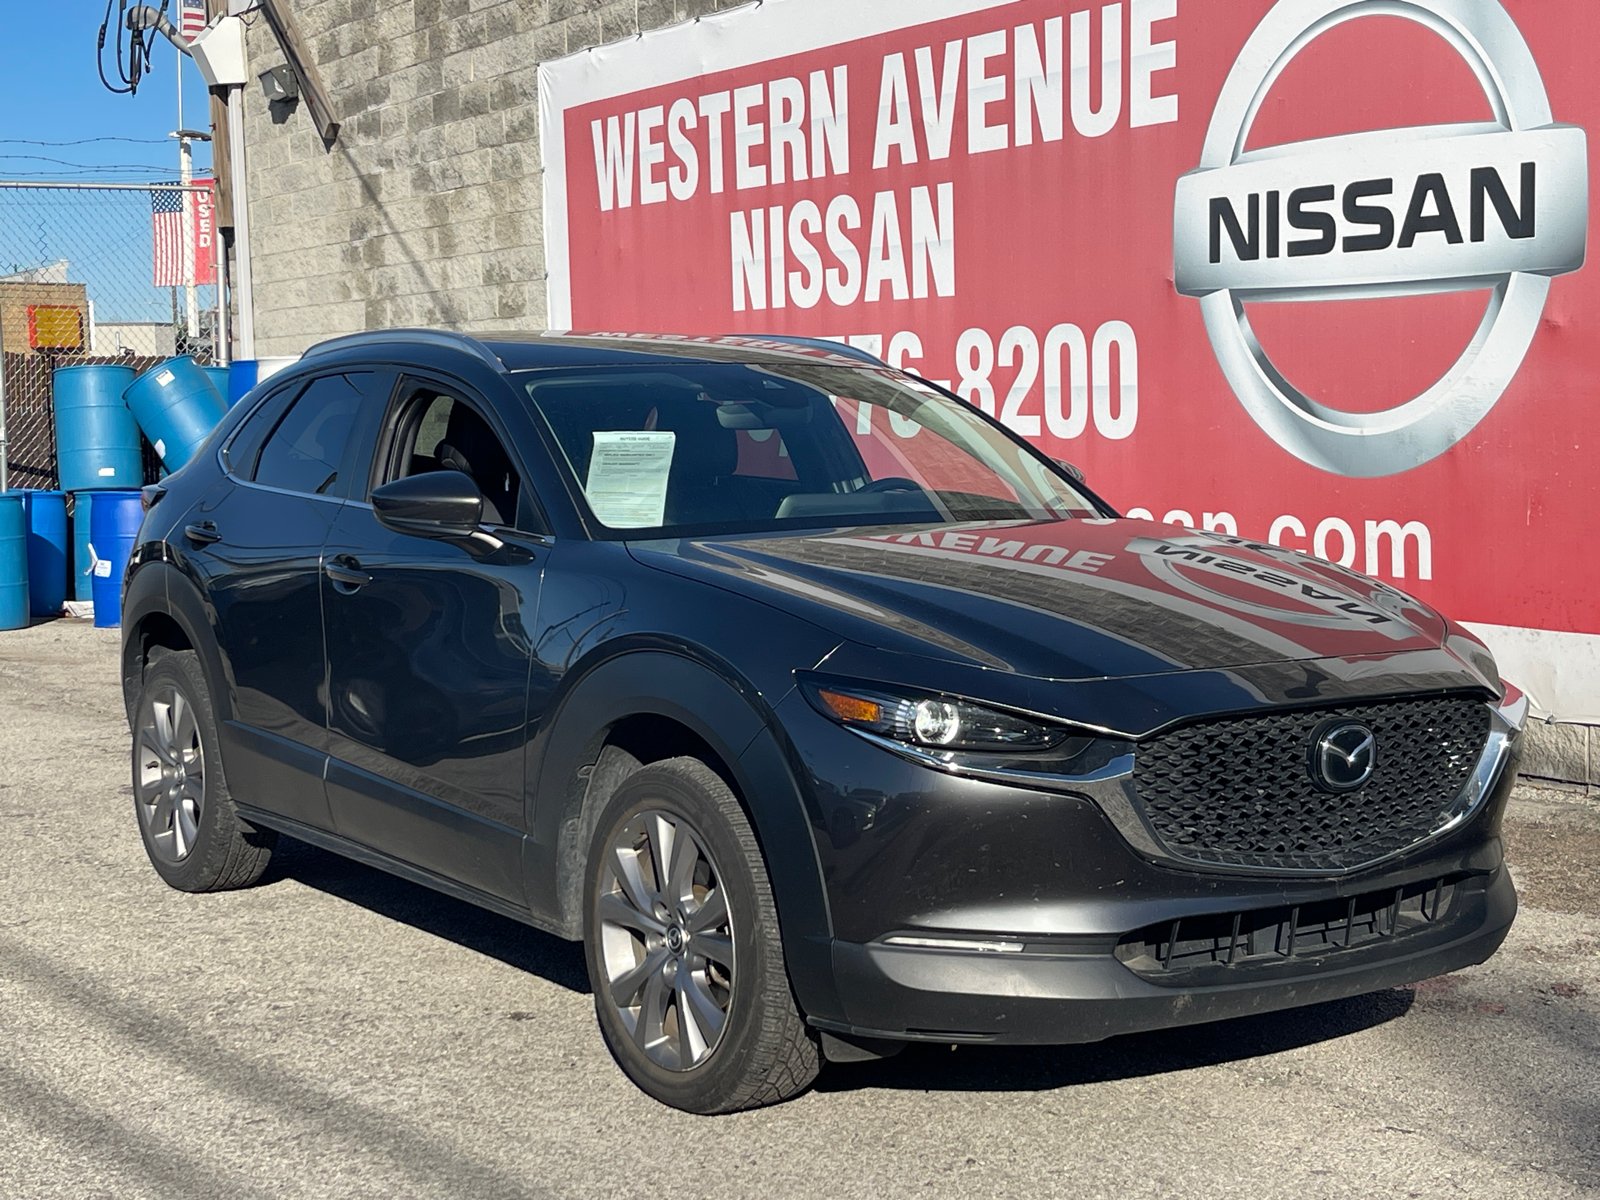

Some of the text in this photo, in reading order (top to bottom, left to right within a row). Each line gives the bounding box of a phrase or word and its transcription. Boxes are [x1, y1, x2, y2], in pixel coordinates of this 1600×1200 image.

[591, 0, 1179, 212] WESTERN AVENUE
[196, 189, 211, 249] USED
[730, 182, 956, 312] NISSAN
[1209, 162, 1536, 264] NISSAN
